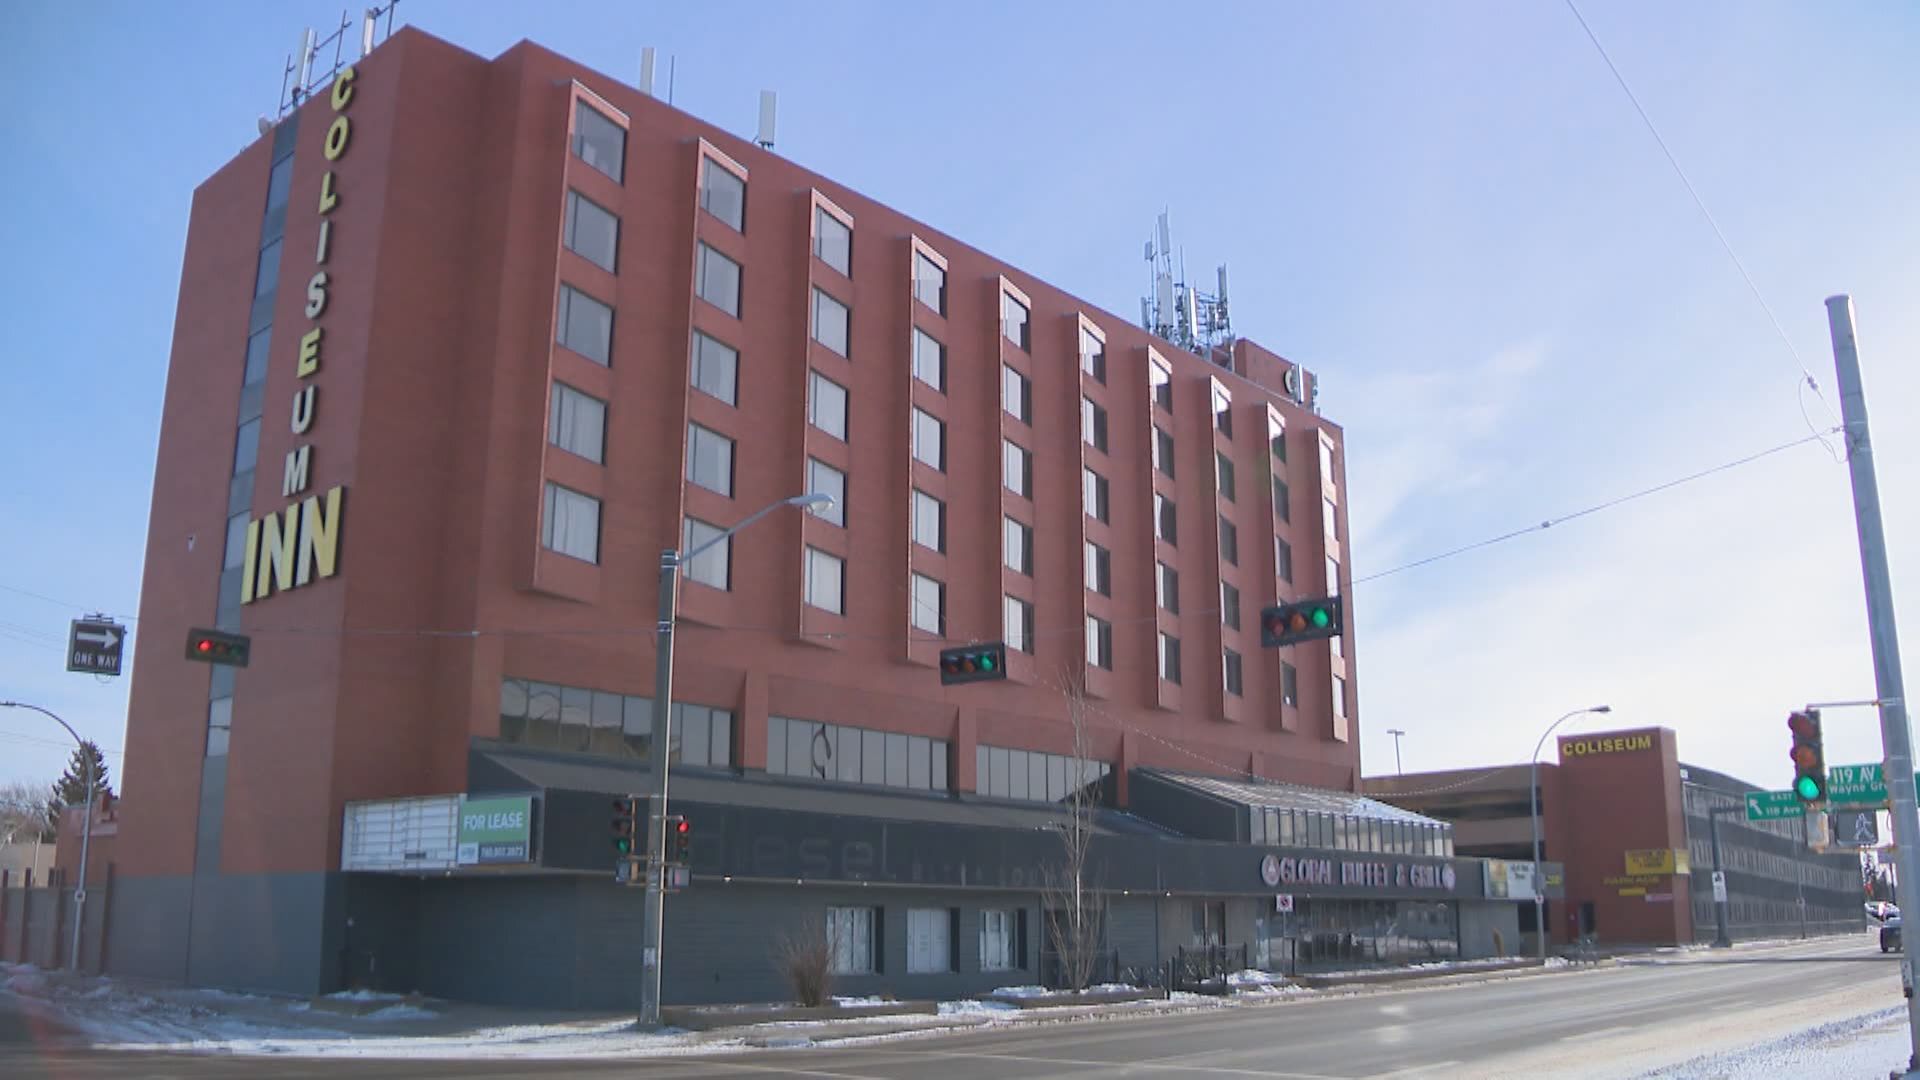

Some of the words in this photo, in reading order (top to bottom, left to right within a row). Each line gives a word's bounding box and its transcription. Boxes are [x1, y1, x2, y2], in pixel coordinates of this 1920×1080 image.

[282, 67, 355, 497] COLISEUM
[240, 485, 343, 604] INN
[74, 651, 94, 665] ONE
[96, 655, 117, 668] WAY
[1562, 735, 1651, 756] COLISEUM
[1832, 768, 1853, 784] 119
[1860, 765, 1876, 783] AV
[1829, 783, 1865, 795] Wayne
[463, 815, 486, 830] FOR
[488, 812, 523, 829] LEASE
[1280, 857, 1331, 884] GLOBAL
